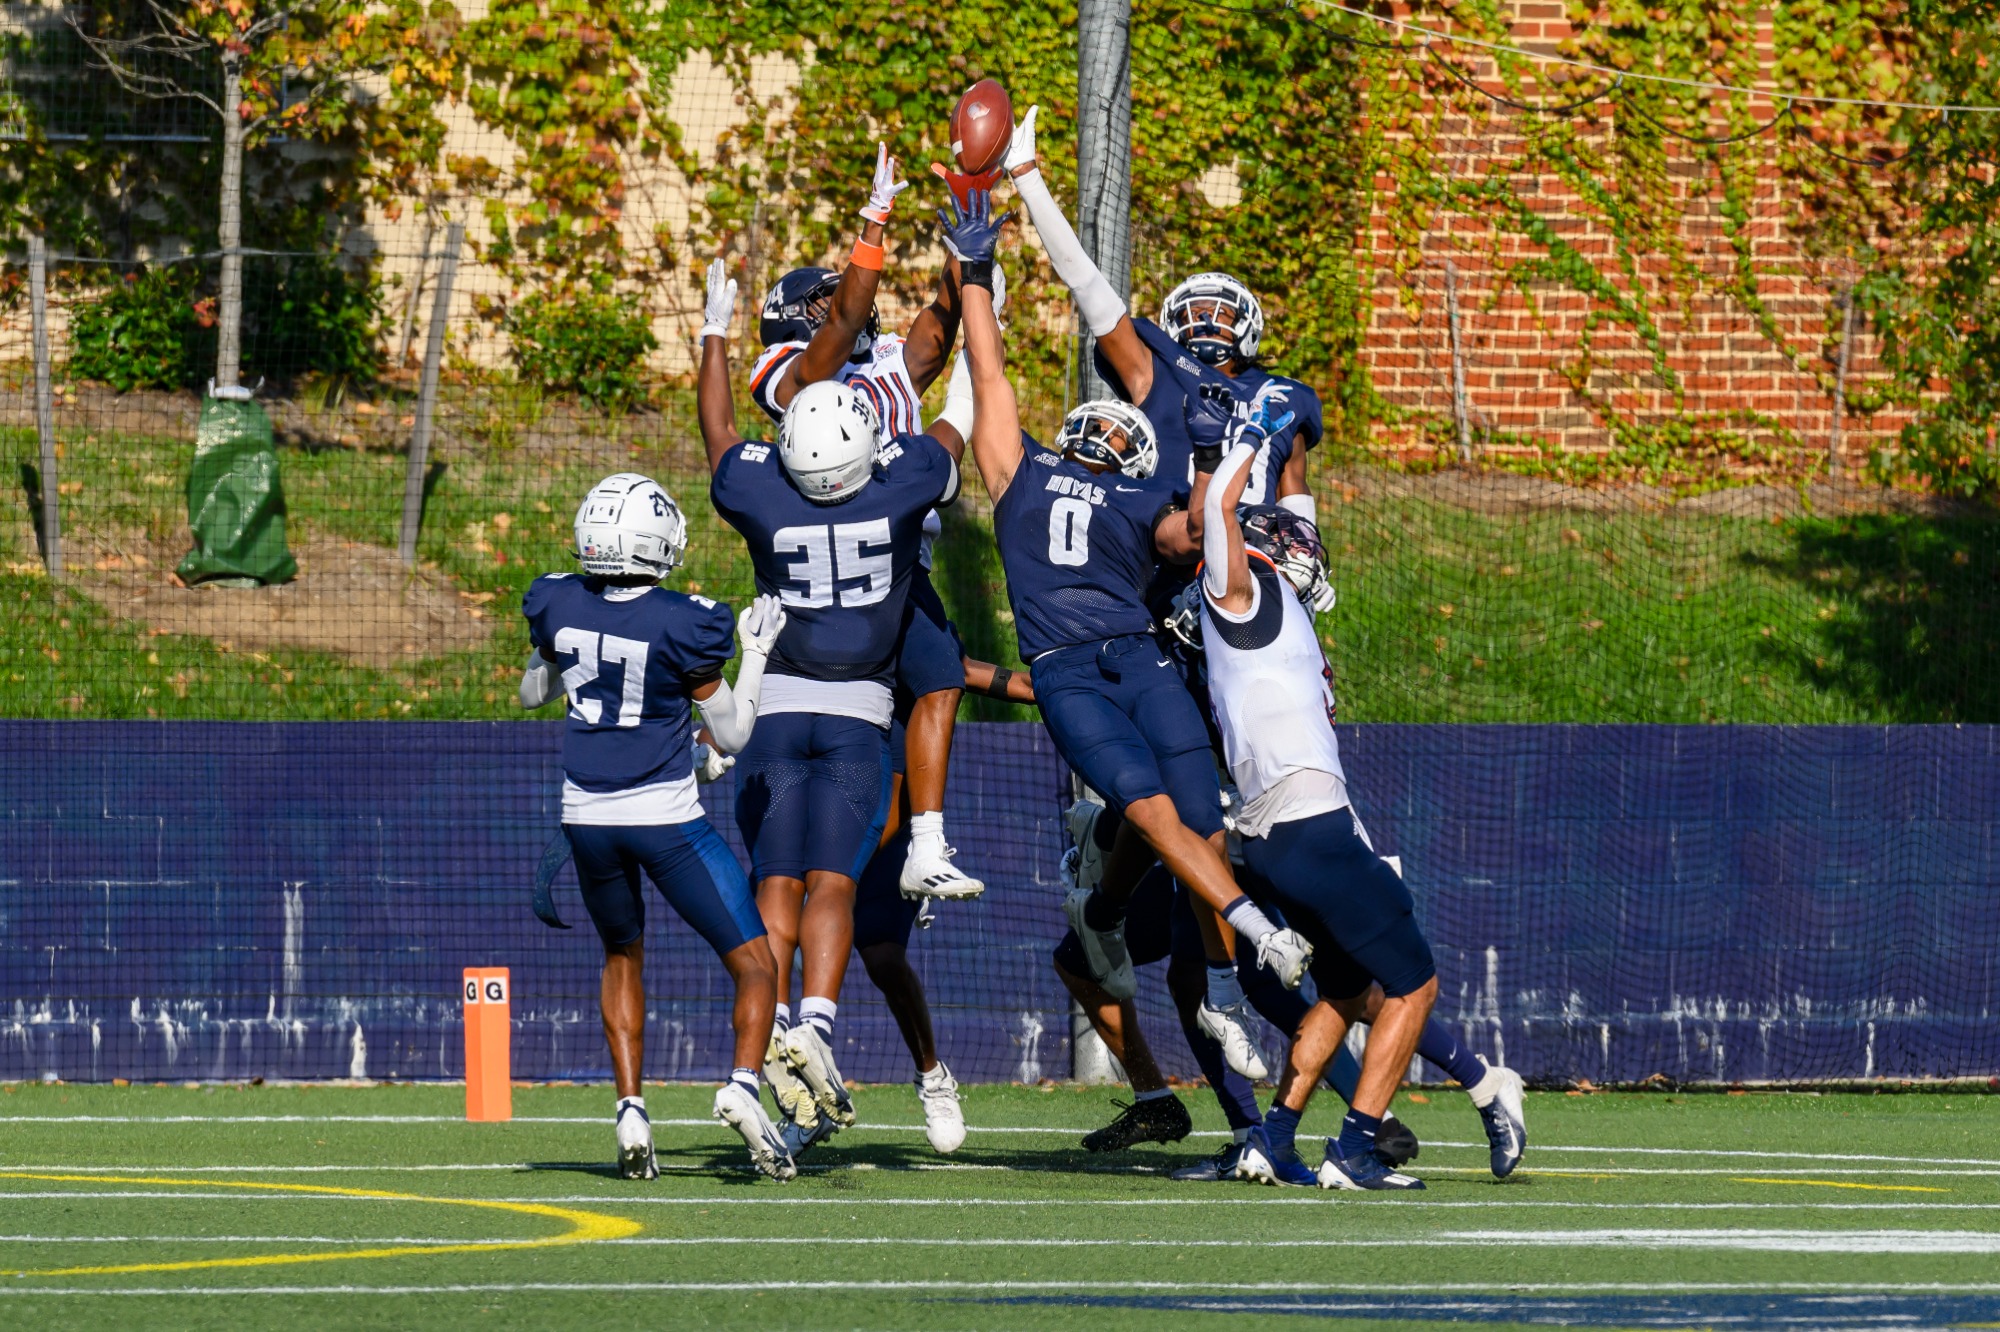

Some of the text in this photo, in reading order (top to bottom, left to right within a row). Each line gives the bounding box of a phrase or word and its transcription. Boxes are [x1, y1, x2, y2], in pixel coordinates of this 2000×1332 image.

[852, 395, 870, 425] 35
[1045, 474, 1107, 505] HOYAS
[1049, 497, 1093, 567] 0
[773, 517, 893, 608] 35
[554, 626, 649, 727] 27
[466, 982, 477, 1001] G
[485, 981, 504, 1001] G
